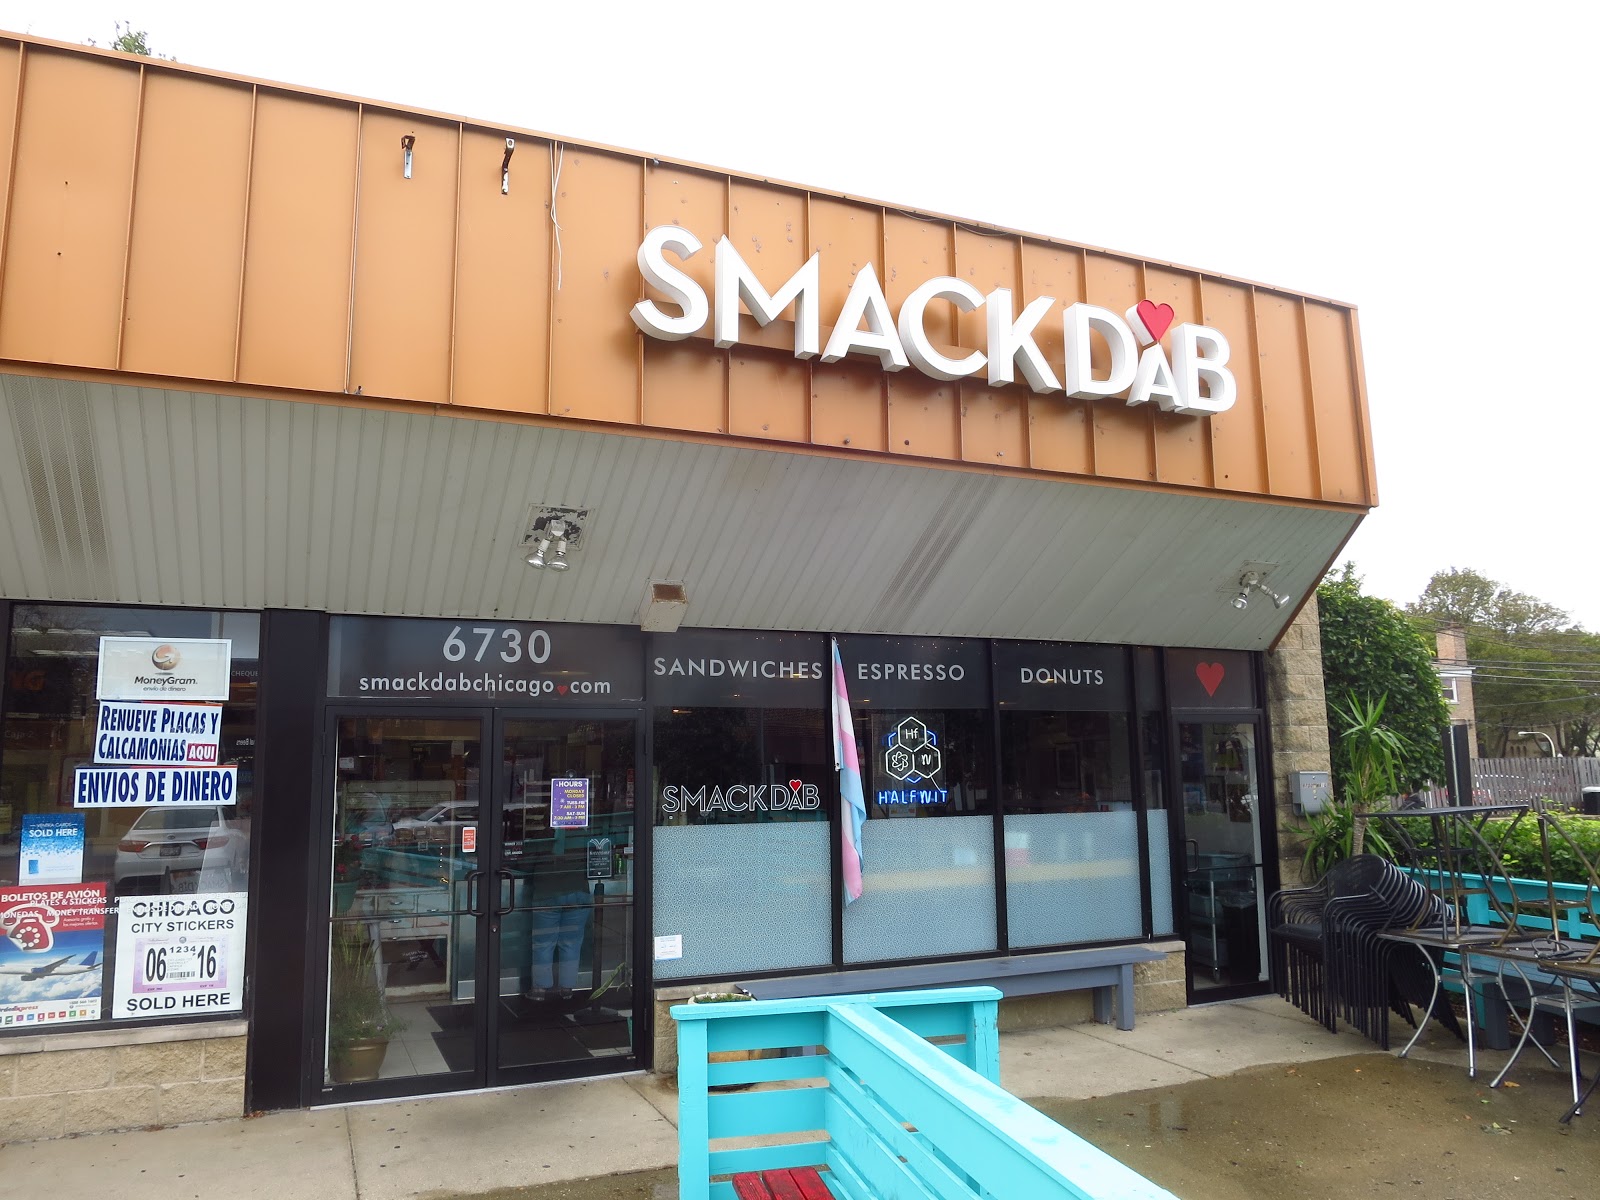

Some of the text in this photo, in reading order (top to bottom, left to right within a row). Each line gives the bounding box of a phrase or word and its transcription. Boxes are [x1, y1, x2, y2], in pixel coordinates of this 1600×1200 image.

[629, 224, 1237, 417] SMACKDAB
[443, 625, 551, 664] 6730
[653, 657, 823, 680] SANDWICHES
[857, 662, 965, 682] ESPRESSO
[1020, 667, 1104, 686] DONUTS
[100, 705, 219, 735] RENUEVE PLACAS Y
[905, 728, 918, 739] Hf
[98, 734, 215, 762] CALCAMONIAS AQUI
[78, 771, 233, 803] ENVIOS DE DINERO
[662, 780, 820, 813] SMACKDAB
[879, 790, 947, 804] HALFWIT
[29, 828, 78, 838] SOLD HERE
[1, 888, 100, 903] BOLETOS DE AVIÓN
[70, 897, 107, 906] STICKERS
[47, 908, 76, 918] MONEY
[79, 907, 120, 916] TRANSFER
[132, 899, 235, 918] CHICAGO
[131, 919, 234, 934] CITY STICKERS
[145, 947, 167, 982] 06
[169, 945, 196, 954] 1234
[197, 944, 217, 979] 16
[127, 992, 230, 1012] SOLD HERE
